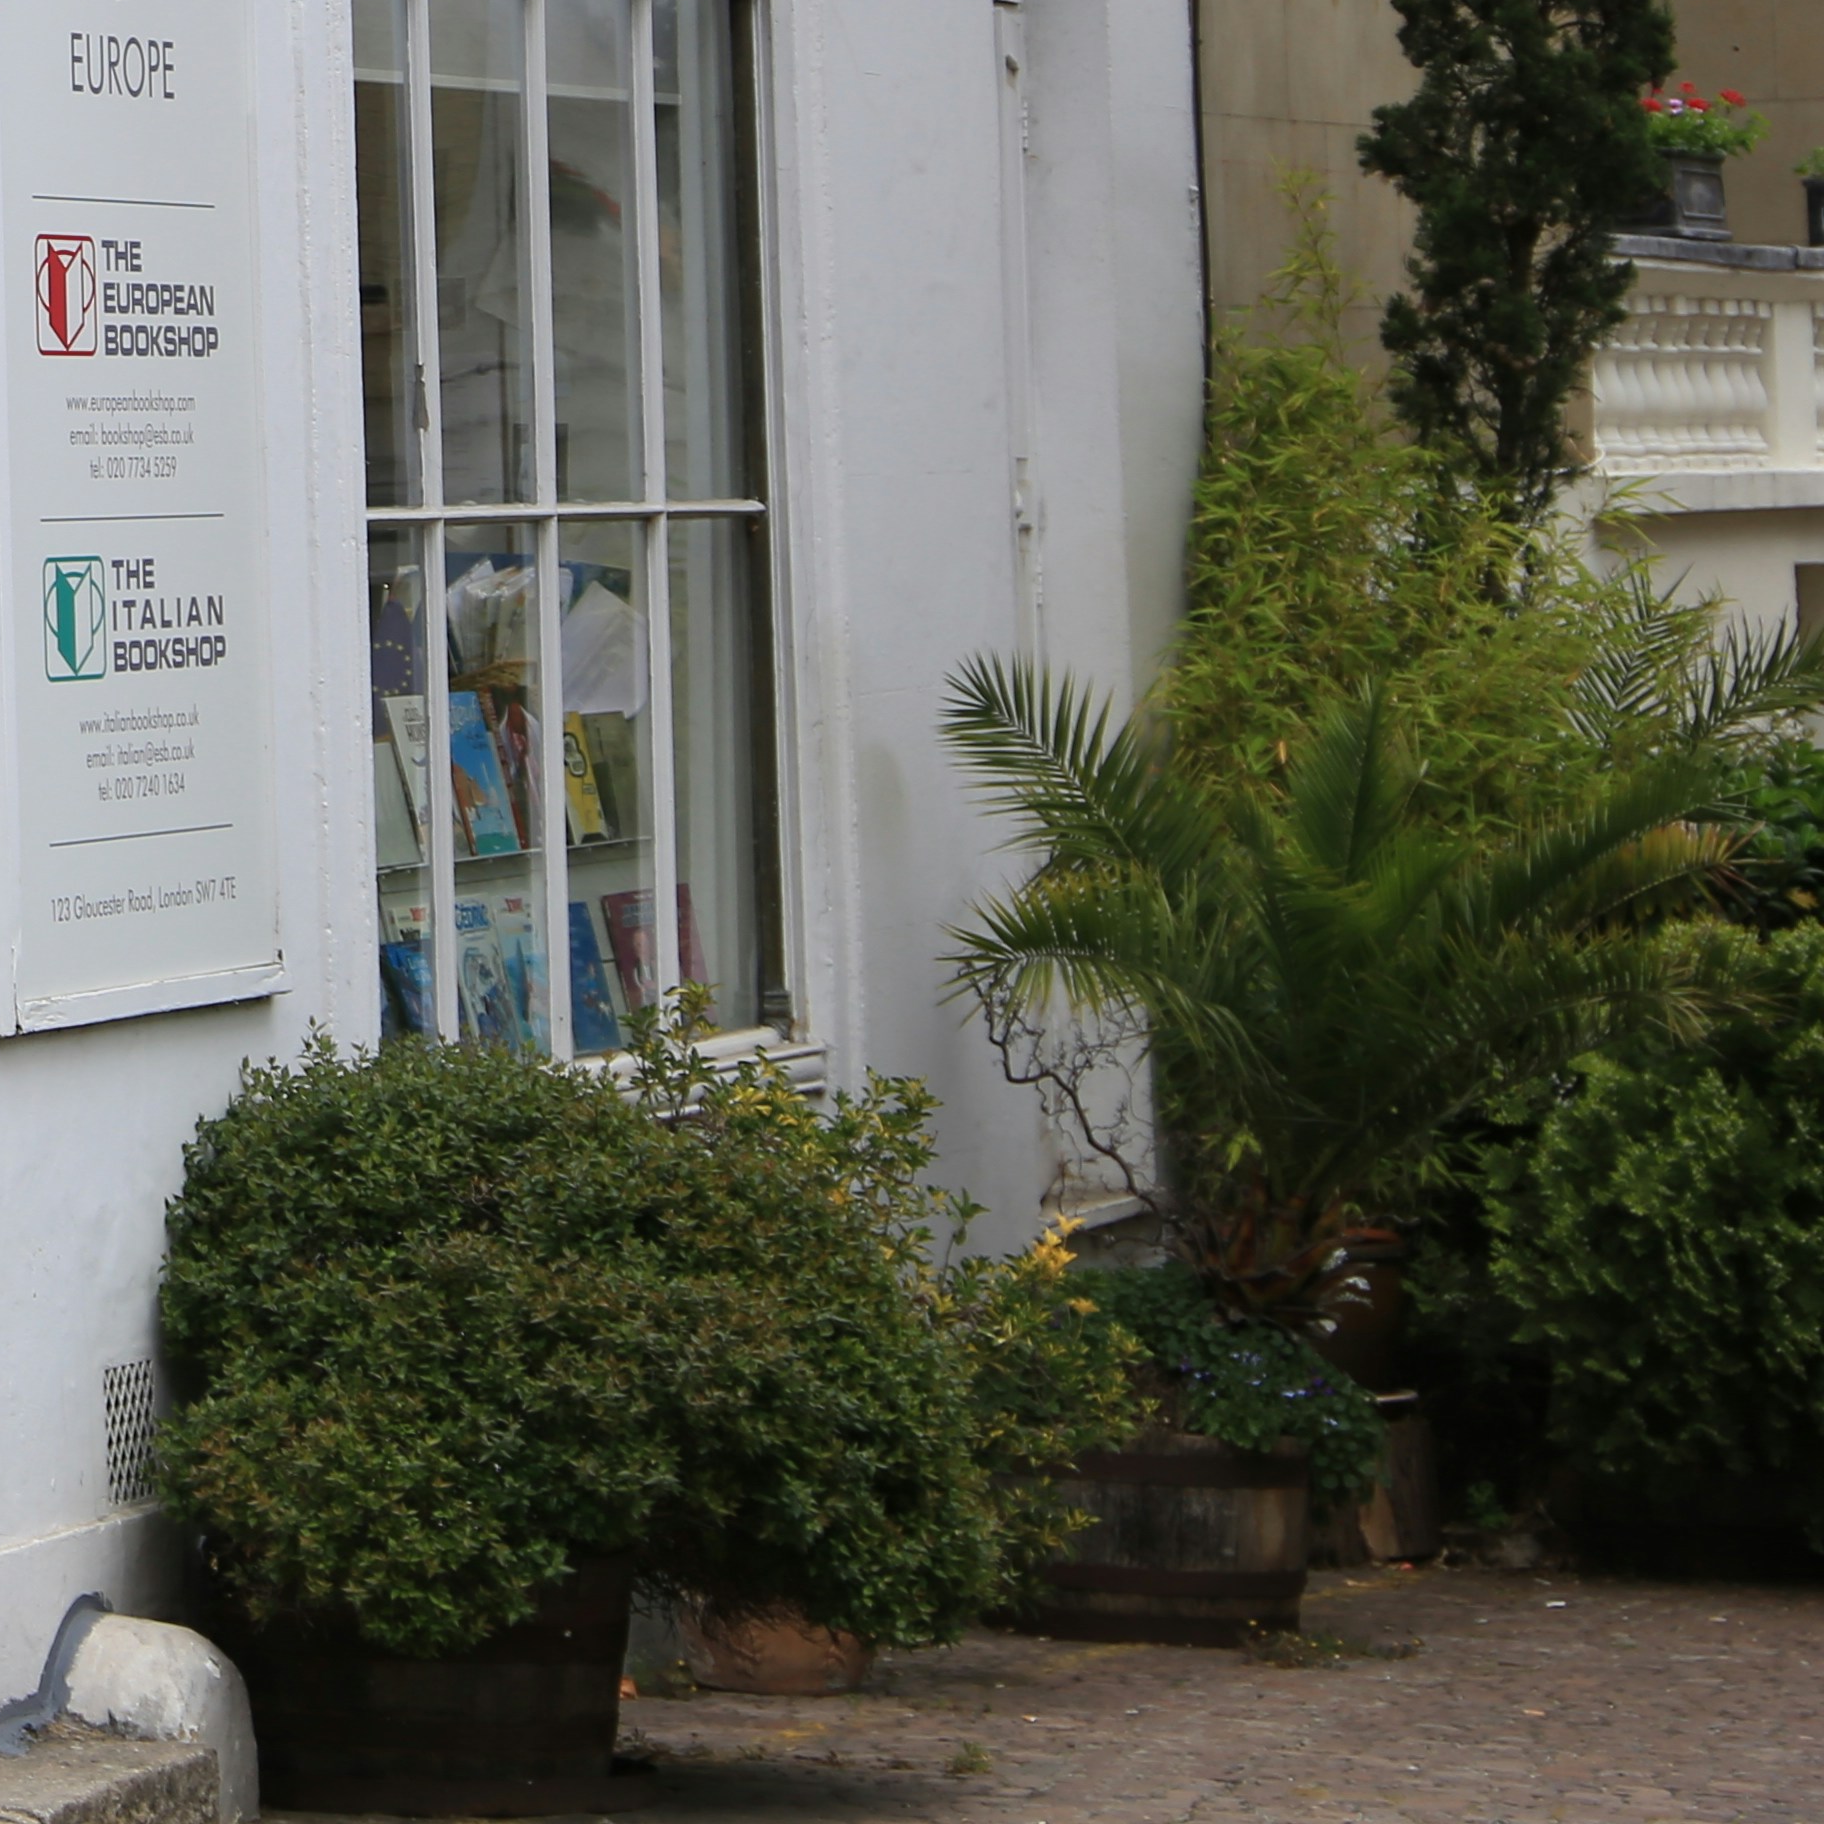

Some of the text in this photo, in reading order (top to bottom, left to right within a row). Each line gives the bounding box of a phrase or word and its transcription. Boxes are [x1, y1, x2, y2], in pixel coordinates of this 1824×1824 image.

[70, 32, 175, 100] EUROPE
[101, 240, 142, 272] THE
[103, 282, 215, 316] EUROPEAN
[104, 324, 219, 358] BOOKSHOP
[66, 390, 196, 417] www.europeanbookshop.com
[70, 423, 195, 449] email: bookshop@esb.co.uk
[89, 456, 177, 479] tel: 020 7734 5259
[111, 558, 155, 591] THE
[112, 595, 224, 632] ITALIAN
[113, 635, 227, 672] BOOKSHOP
[79, 704, 200, 736] www.italianbookshop.co.uk
[86, 739, 195, 768] email: italian@esb.co.uk
[98, 773, 185, 801] tel: 020 7240 1634
[52, 876, 237, 922] 123 Gloucester Road, London SW7 4TE
